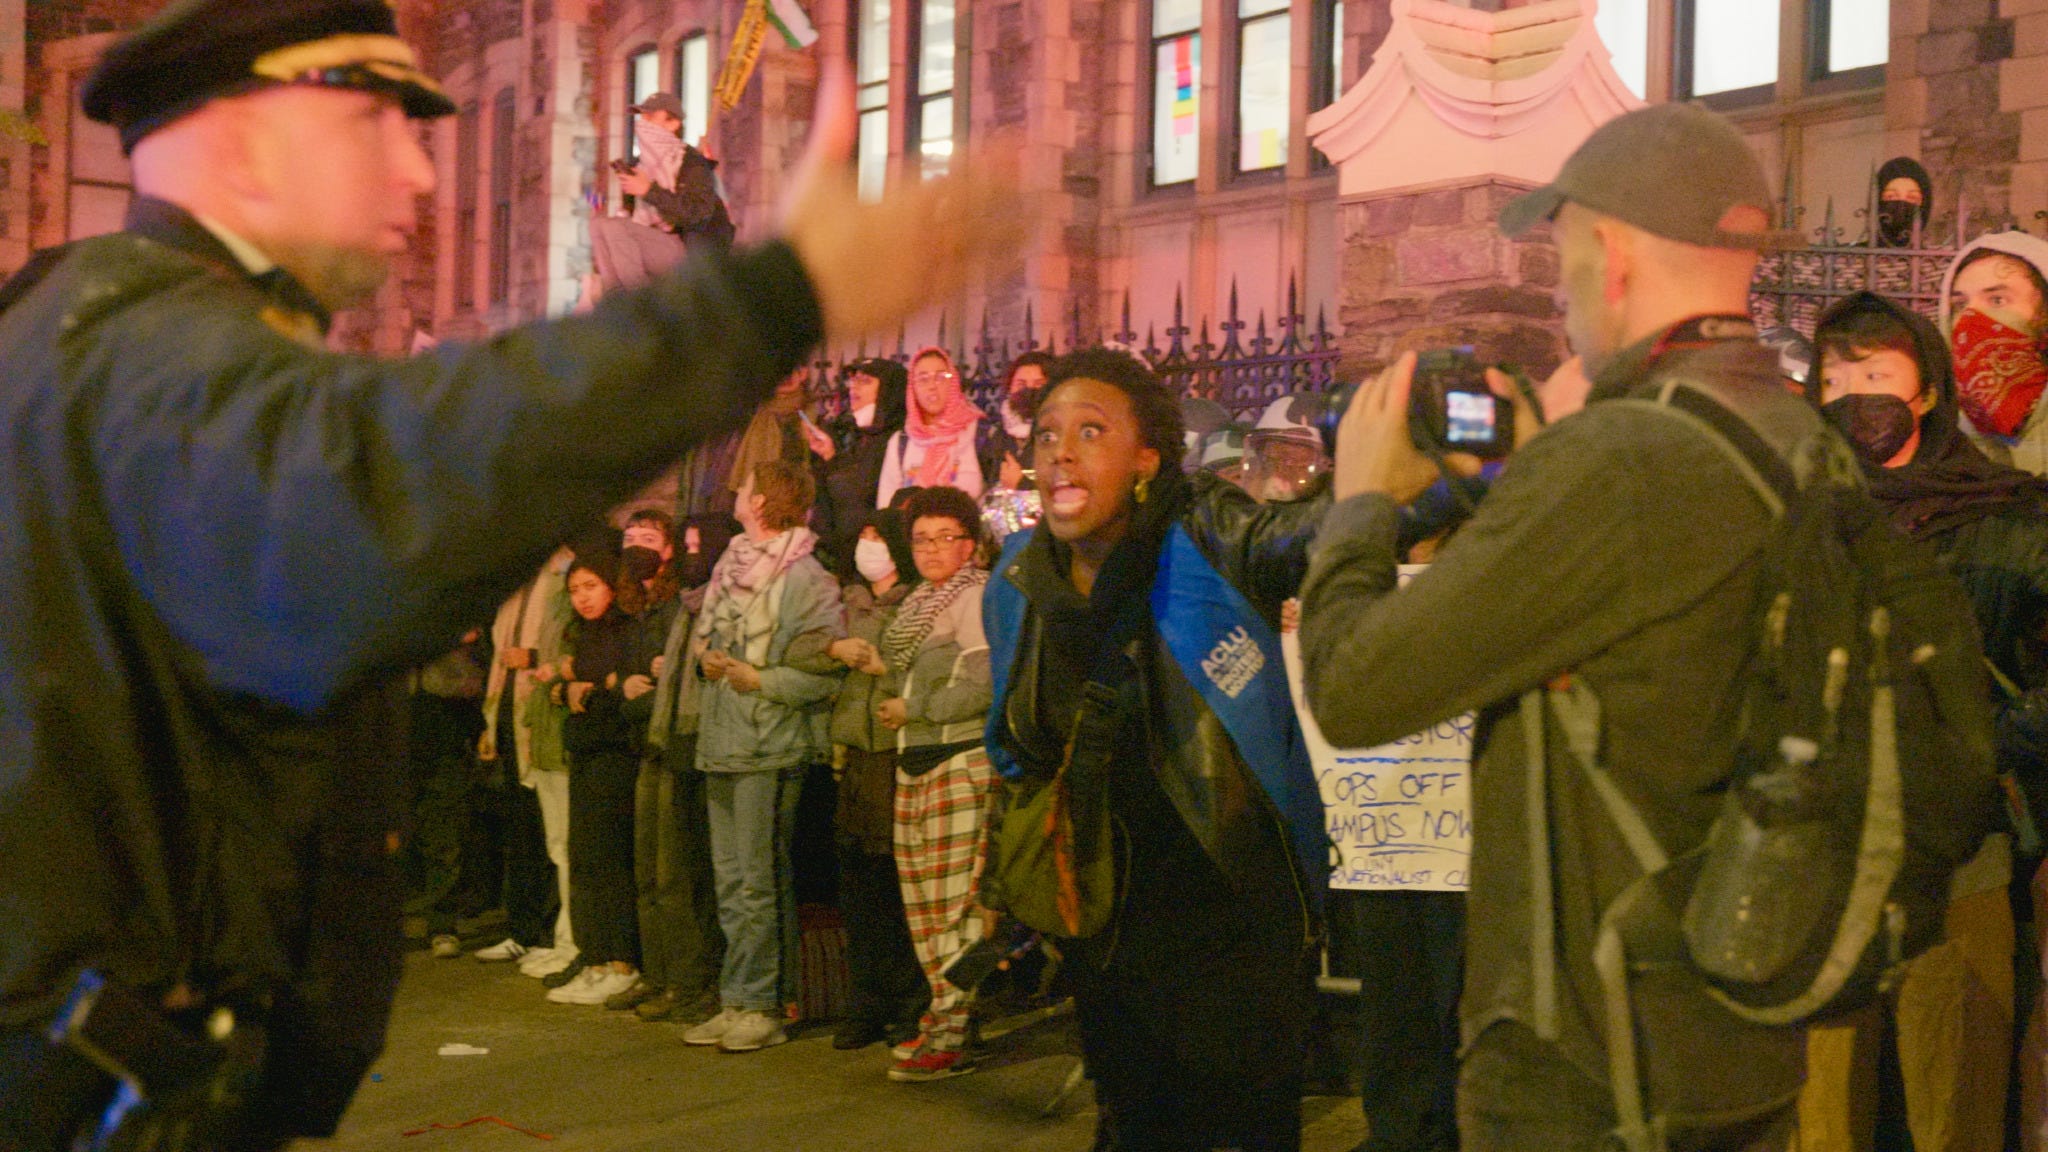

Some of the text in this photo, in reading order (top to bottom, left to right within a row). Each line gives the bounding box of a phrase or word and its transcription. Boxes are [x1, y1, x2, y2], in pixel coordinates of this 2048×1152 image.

[1200, 625, 1249, 681] ACLU
[1399, 773, 1462, 799] OFF
[1329, 812, 1406, 845] AMPUS
[1444, 869, 1472, 887] CL
